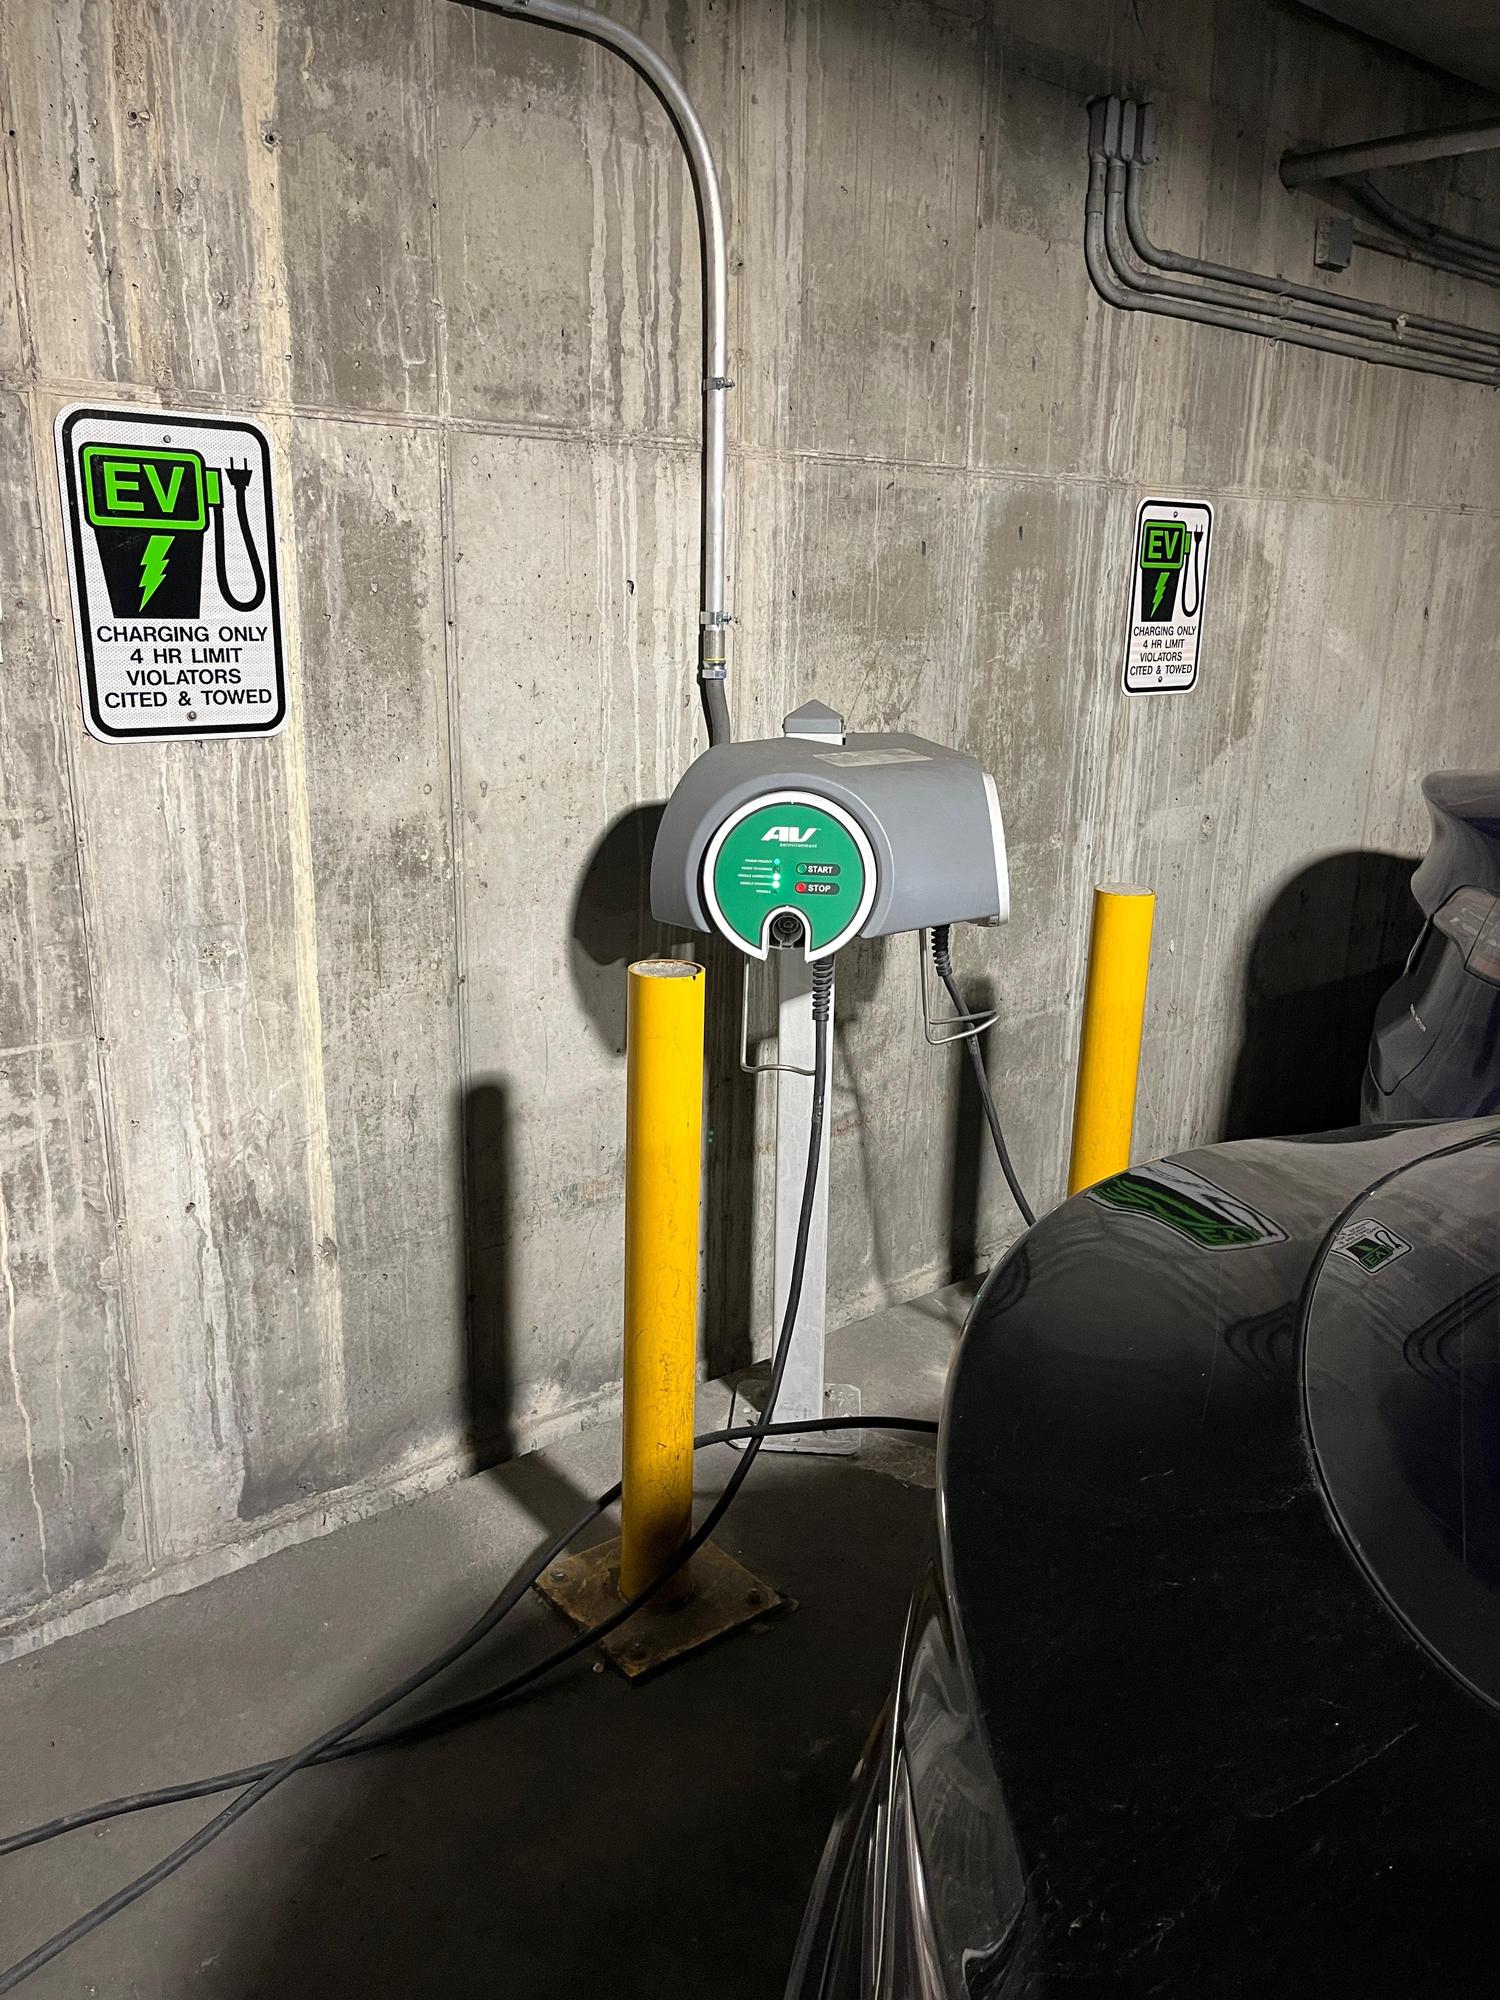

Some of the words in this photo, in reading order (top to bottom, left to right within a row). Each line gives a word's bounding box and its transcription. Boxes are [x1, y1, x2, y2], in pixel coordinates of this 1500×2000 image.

[103, 461, 184, 513] EV
[1148, 530, 1179, 559] EV
[97, 626, 209, 642] CHARGING
[218, 626, 268, 642] ONLY
[1133, 626, 1174, 636] CHARGING
[1177, 626, 1196, 635] ONLY
[1143, 640, 1148, 649] 4
[1151, 639, 1162, 649] HR
[1165, 639, 1185, 648] LIMIT
[130, 648, 143, 664] 4
[153, 648, 182, 664] HR
[191, 648, 243, 663] LIMIT
[1140, 652, 1182, 662] VIOLATORS
[1130, 666, 1153, 675] CITED
[1156, 665, 1161, 674] &
[1165, 664, 1192, 674] TOWED
[126, 669, 241, 686] VIOLATORS
[105, 692, 167, 708] CITED
[178, 691, 192, 706] &
[201, 689, 272, 705] TOWED
[807, 865, 833, 873] START
[807, 884, 831, 892] STOP
